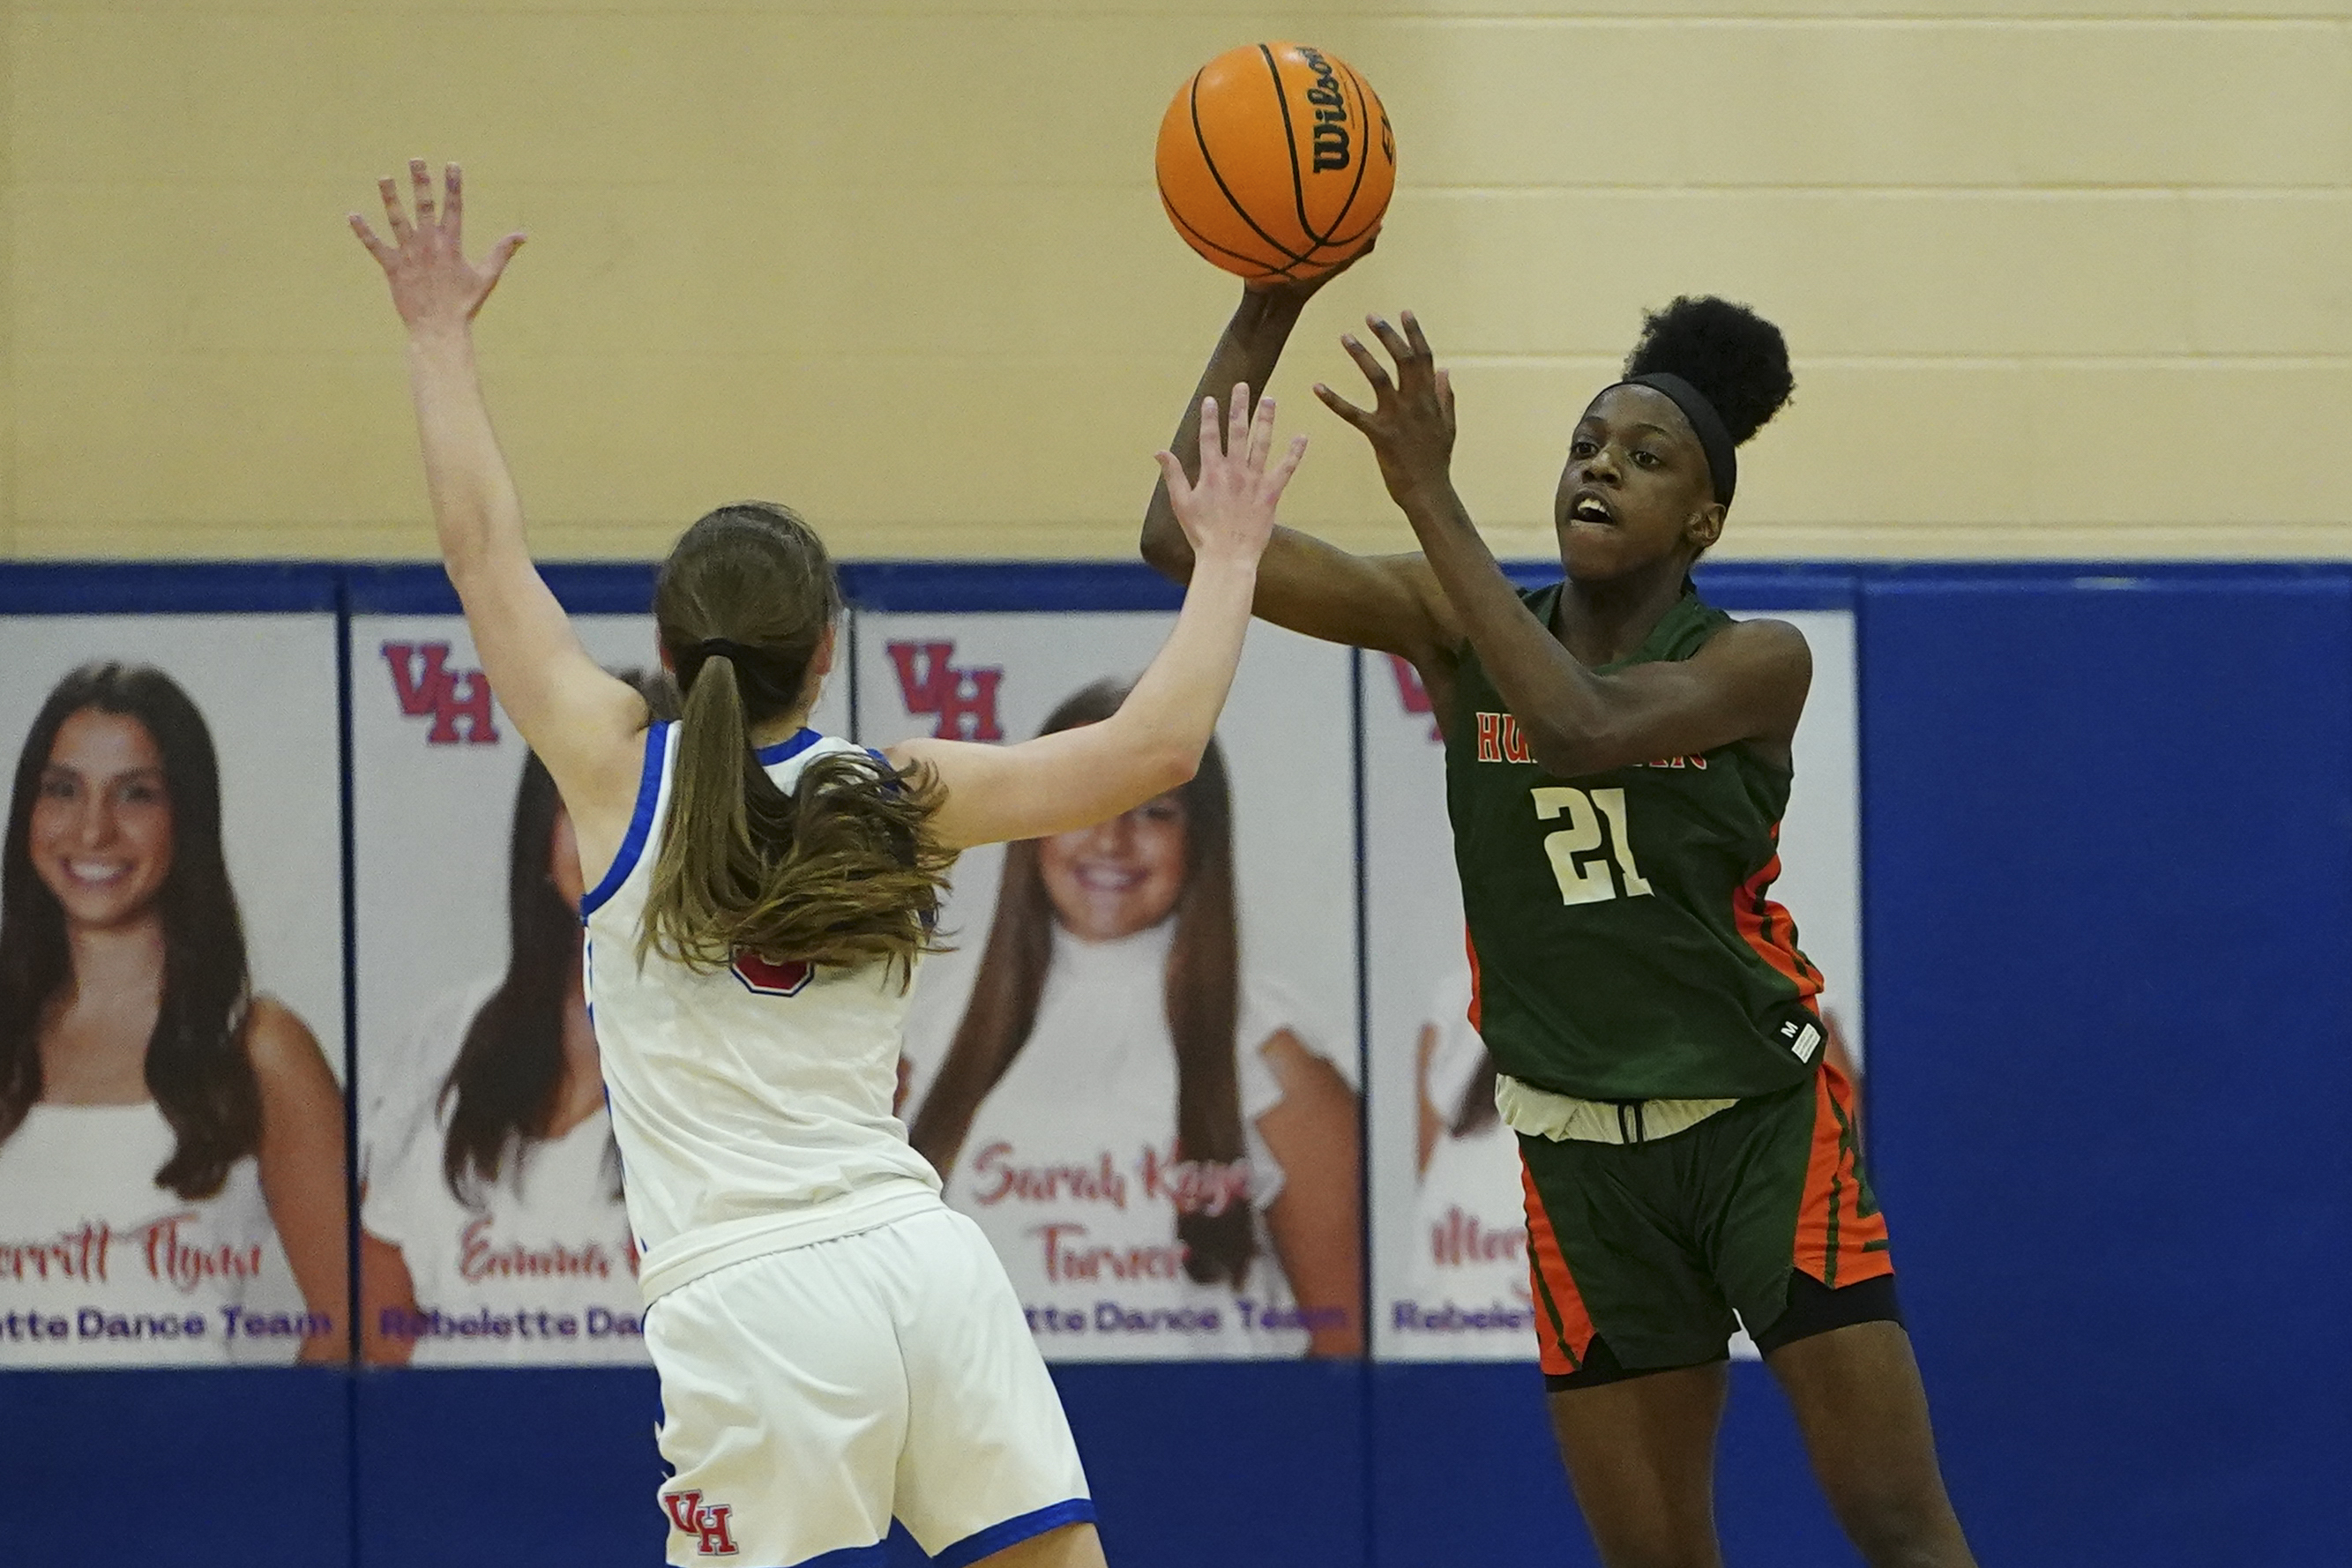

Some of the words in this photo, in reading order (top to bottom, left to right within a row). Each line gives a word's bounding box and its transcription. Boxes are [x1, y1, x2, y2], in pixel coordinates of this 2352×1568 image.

[1295, 45, 1350, 173] Wilson
[379, 640, 500, 744] VH
[885, 639, 1004, 742] VH
[1530, 787, 1655, 907] 21
[972, 1142, 1126, 1212] Sarah
[78, 1306, 206, 1341] Dance
[220, 1304, 333, 1340] Team
[1094, 1300, 1221, 1333] Dance
[663, 1489, 740, 1557] VH
